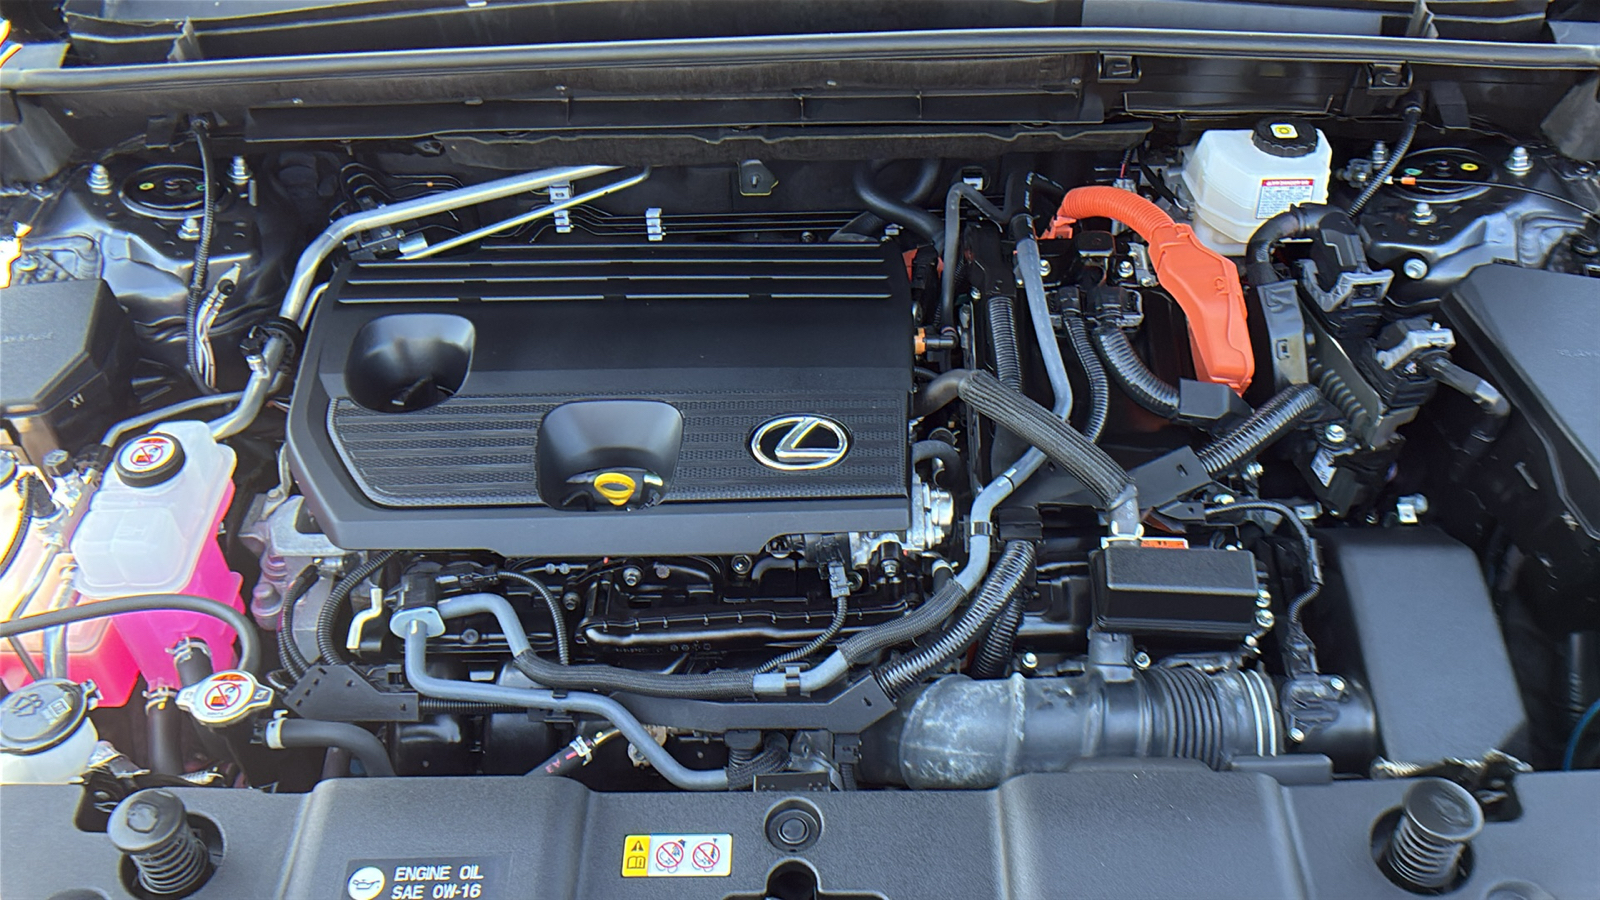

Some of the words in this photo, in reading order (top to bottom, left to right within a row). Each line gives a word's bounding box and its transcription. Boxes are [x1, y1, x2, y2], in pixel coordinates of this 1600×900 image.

[394, 865, 452, 881] ENGINE
[459, 864, 484, 880] OIL
[391, 884, 425, 900] SAE
[432, 883, 482, 899] 0W-16
